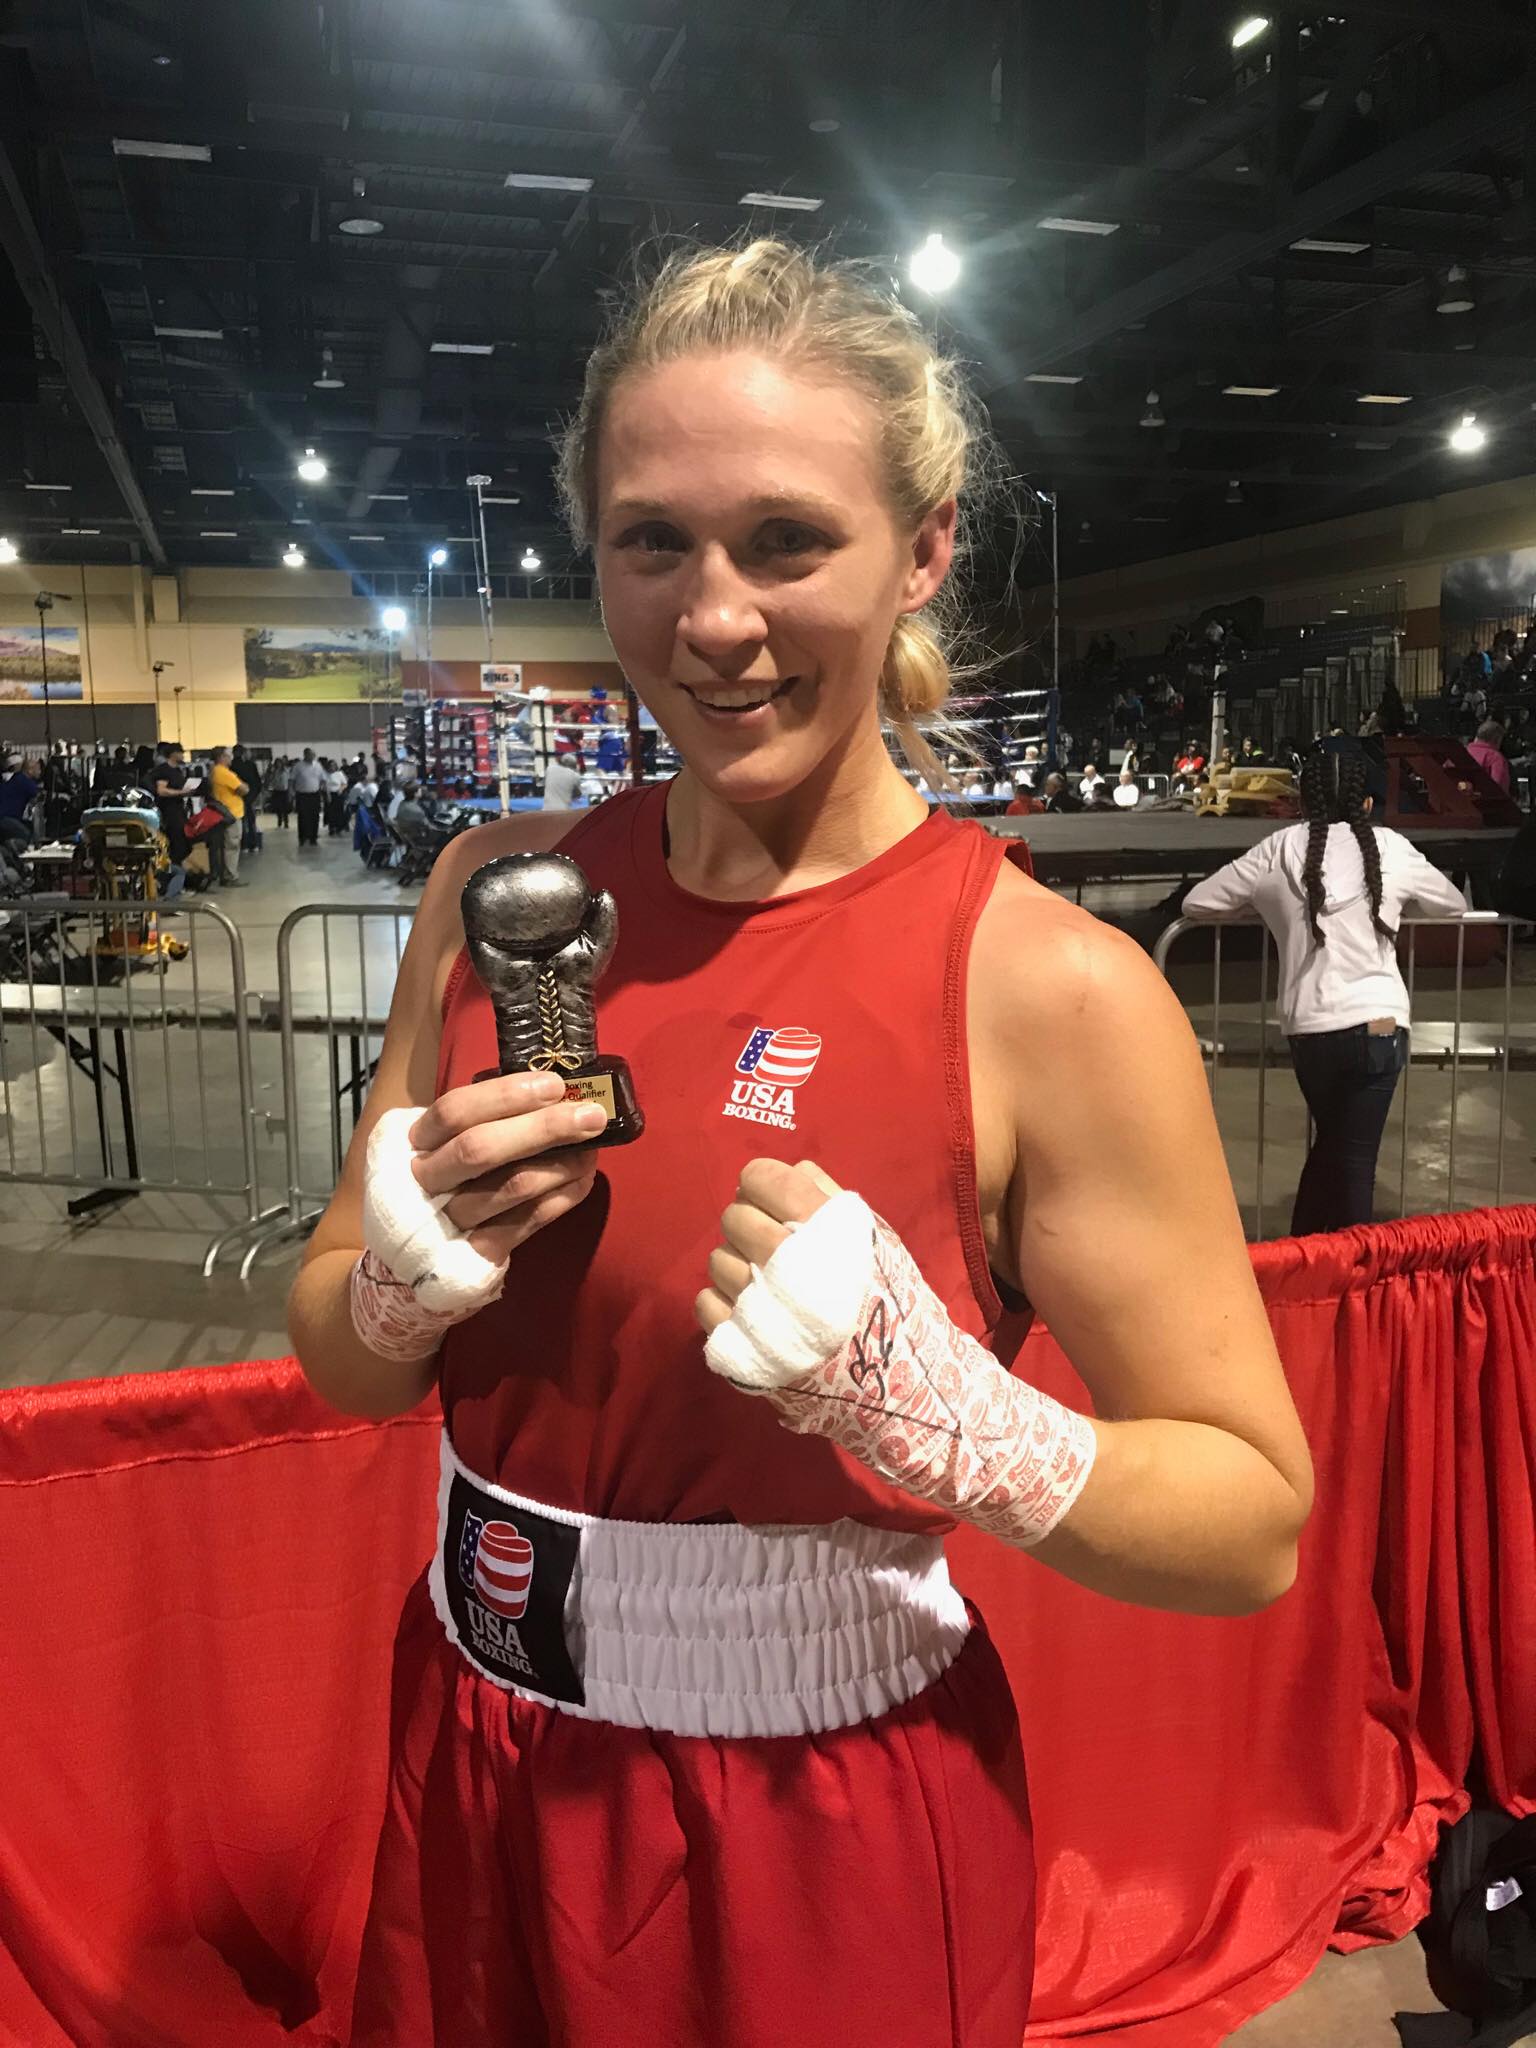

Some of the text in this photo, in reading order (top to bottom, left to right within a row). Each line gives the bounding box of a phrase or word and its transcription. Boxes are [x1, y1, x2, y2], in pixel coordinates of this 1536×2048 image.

[483, 673, 520, 683] RING 3
[568, 1090, 606, 1101] Qualifier
[730, 1080, 795, 1115] USA
[1016, 1459, 1045, 1491] USA
[1034, 1496, 1065, 1523] USA
[464, 1596, 529, 1660] USA
[470, 1629, 534, 1676] BOXING
